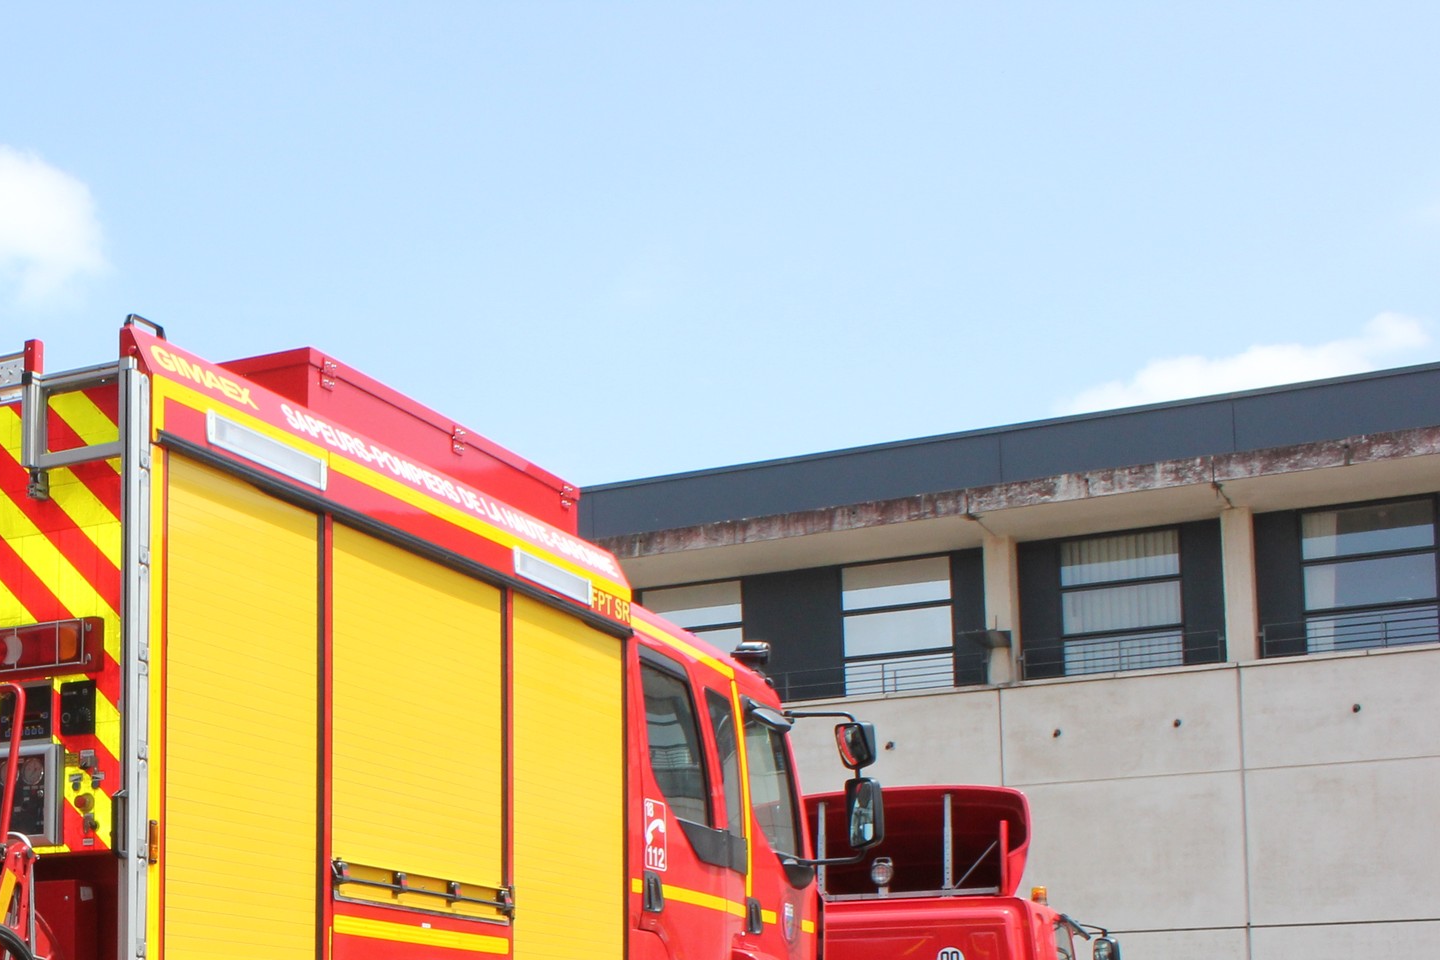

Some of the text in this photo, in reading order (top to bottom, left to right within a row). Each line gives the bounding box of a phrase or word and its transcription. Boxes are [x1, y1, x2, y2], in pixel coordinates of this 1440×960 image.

[150, 345, 259, 411] GIMAEX
[281, 403, 619, 579] SAPEURS-POMPIERS DE LA HAUTE-GARONNE
[591, 589, 631, 624] FPT SR
[645, 802, 655, 818] 18
[647, 845, 665, 869] 112
